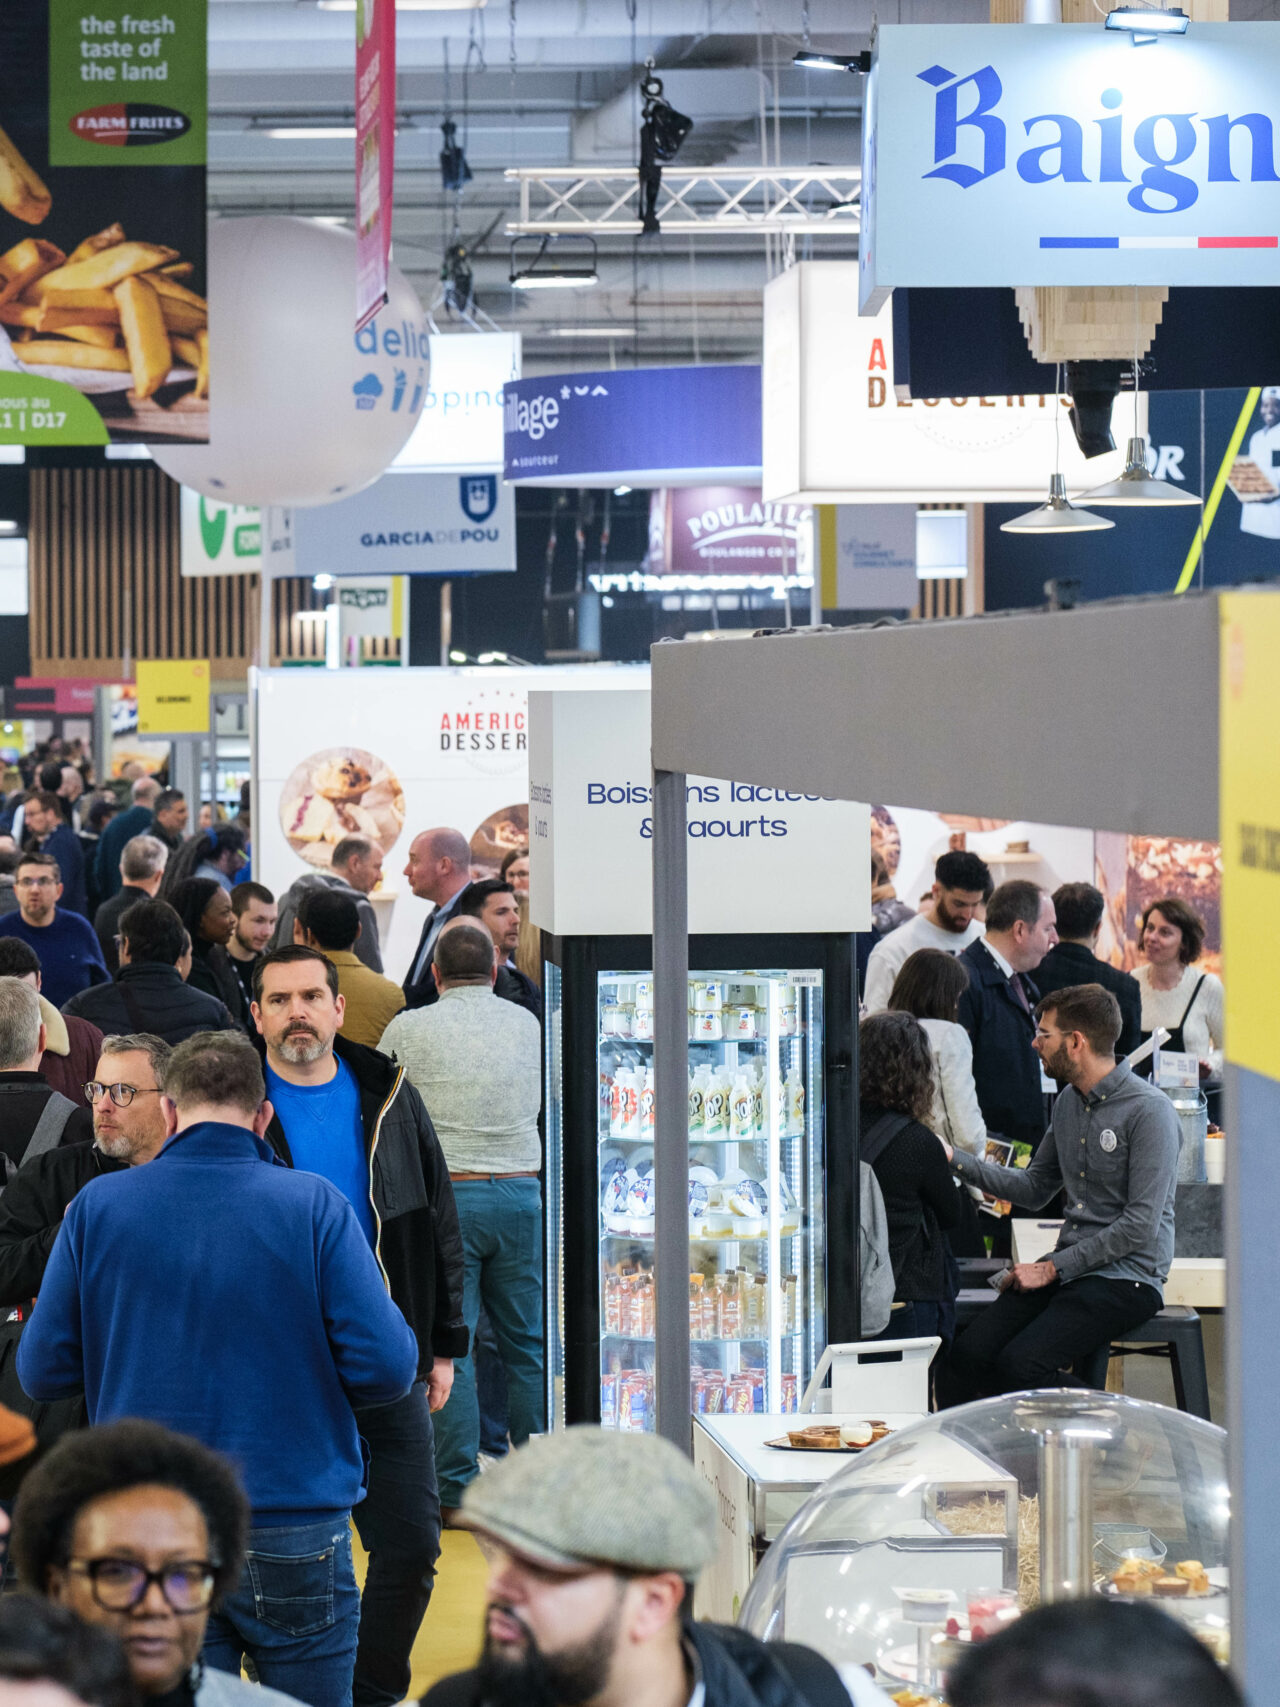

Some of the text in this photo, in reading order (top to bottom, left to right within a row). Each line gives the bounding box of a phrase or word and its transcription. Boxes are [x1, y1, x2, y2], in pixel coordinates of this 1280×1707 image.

[81, 14, 176, 34] the fresh
[81, 37, 162, 58] taste of
[81, 61, 169, 81] the land
[77, 117, 184, 129] FARM FRITES
[915, 64, 1280, 214] Baign
[31, 398, 50, 410] au
[32, 412, 67, 428] D17
[685, 815, 789, 838] aourts
